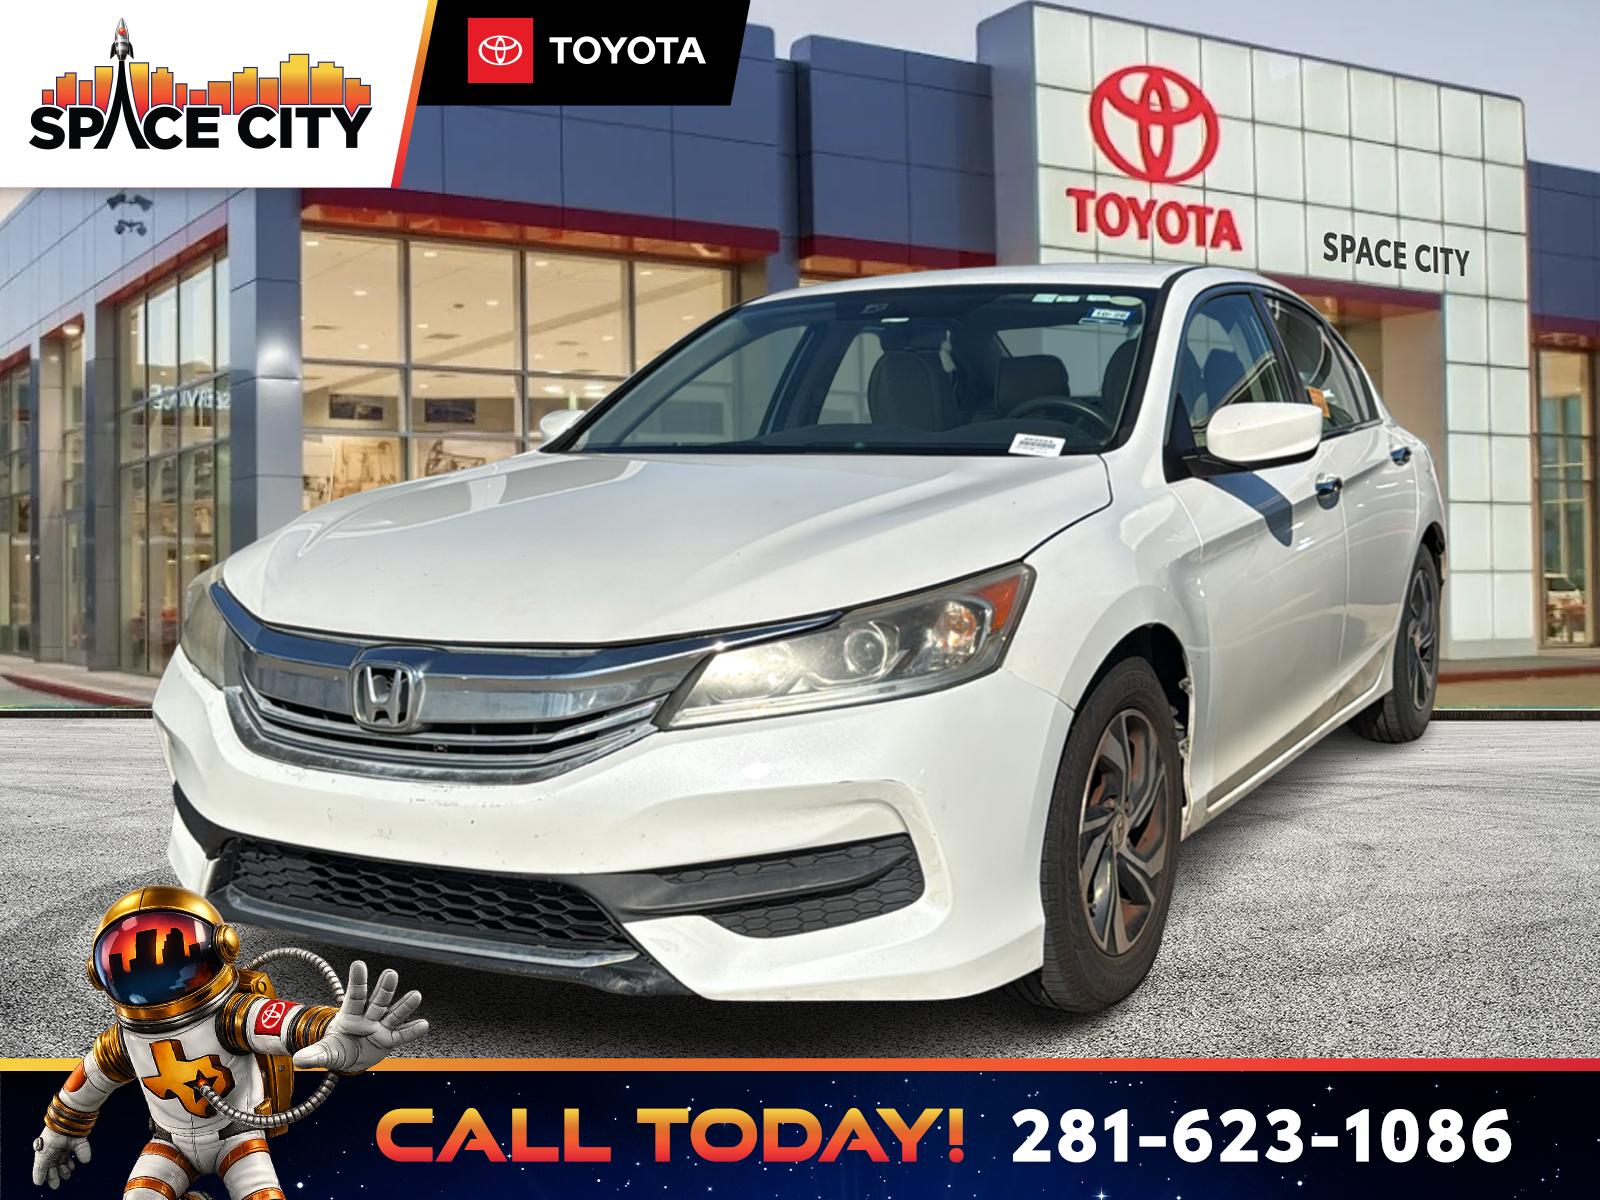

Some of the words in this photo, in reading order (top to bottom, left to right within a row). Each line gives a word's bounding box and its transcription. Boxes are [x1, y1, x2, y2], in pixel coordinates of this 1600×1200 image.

[1066, 187, 1242, 251] TOYOTA
[1322, 231, 1407, 270] SPACE
[1414, 244, 1470, 278] CITY
